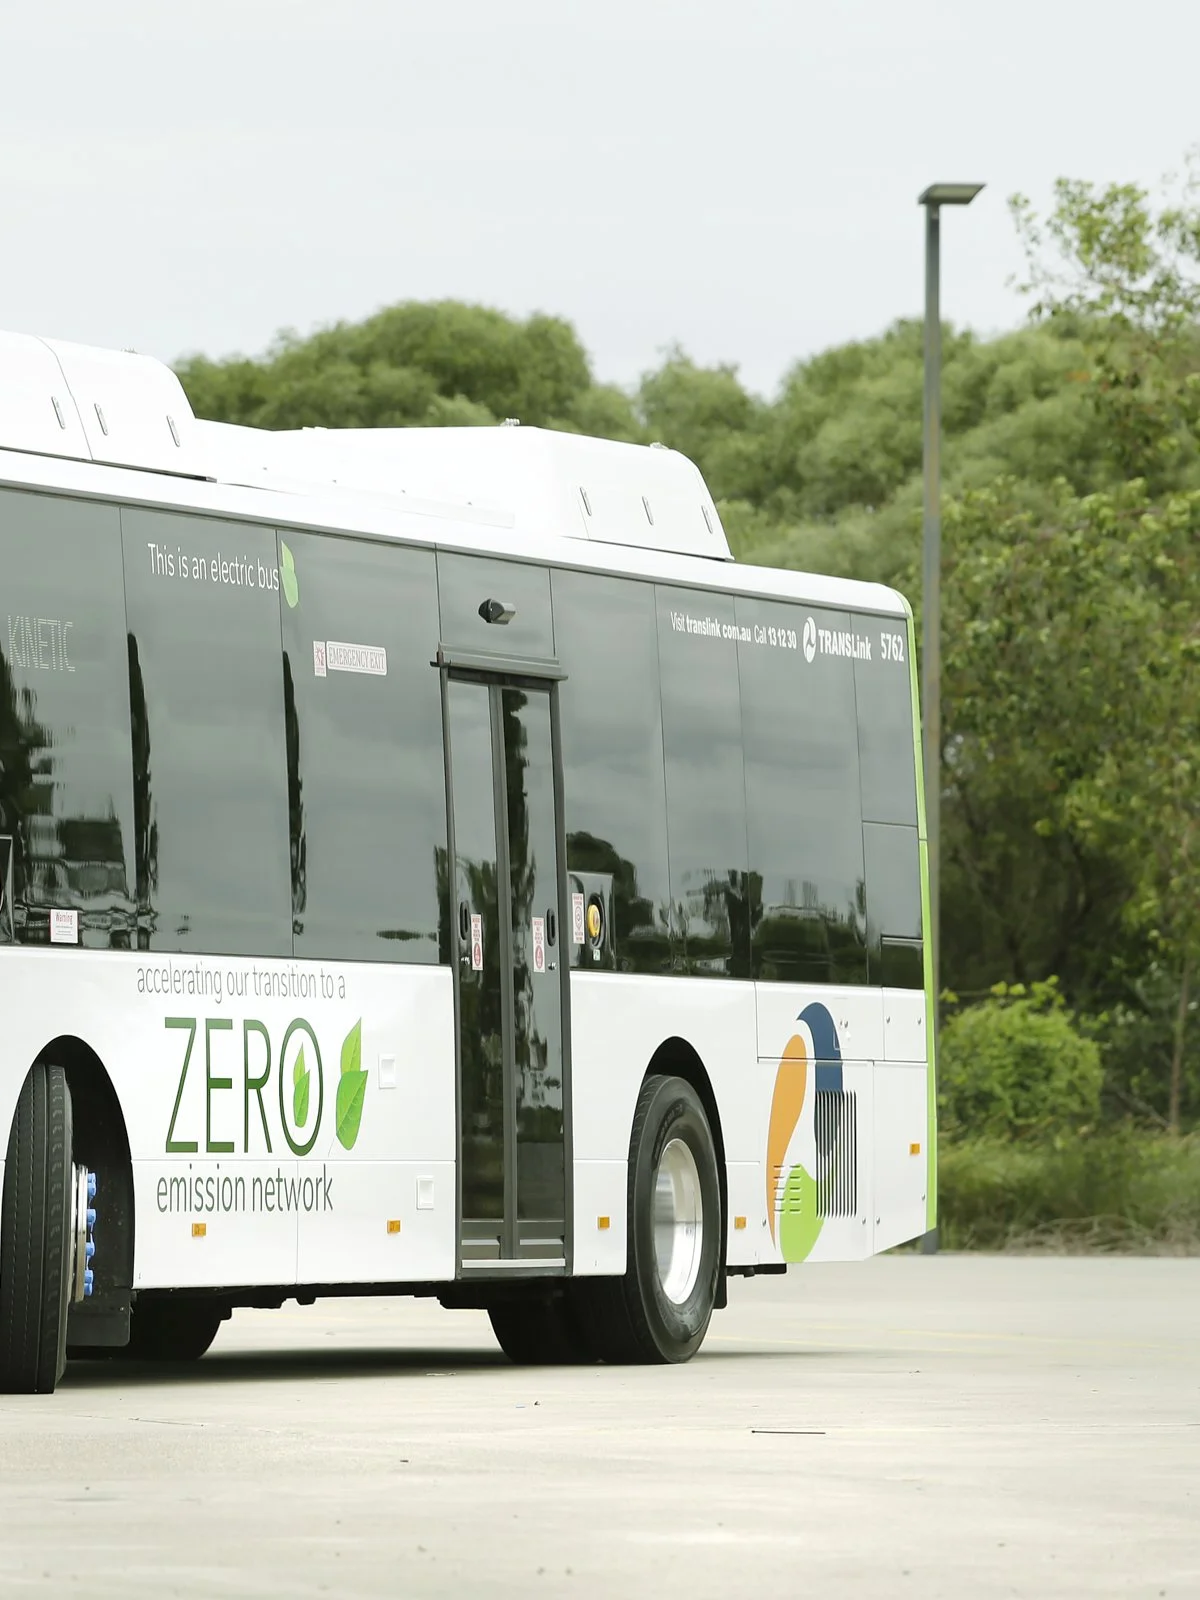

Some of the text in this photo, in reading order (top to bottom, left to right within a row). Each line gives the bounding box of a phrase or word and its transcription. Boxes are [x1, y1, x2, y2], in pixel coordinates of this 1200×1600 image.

[147, 543, 280, 591] This is an electric bus
[7, 615, 76, 672] KINETIC
[670, 611, 686, 632] Visit
[754, 624, 767, 644] Call
[768, 626, 777, 646] 13
[778, 628, 786, 648] 12
[787, 629, 797, 649] 30
[818, 628, 872, 660] TRANSLink
[880, 632, 905, 662] 5762
[328, 646, 385, 670] EMERGENCY EXIT
[137, 959, 346, 1004] accelerating our transition to a
[164, 1016, 324, 1157] ZERO
[156, 1162, 334, 1213] emission network
